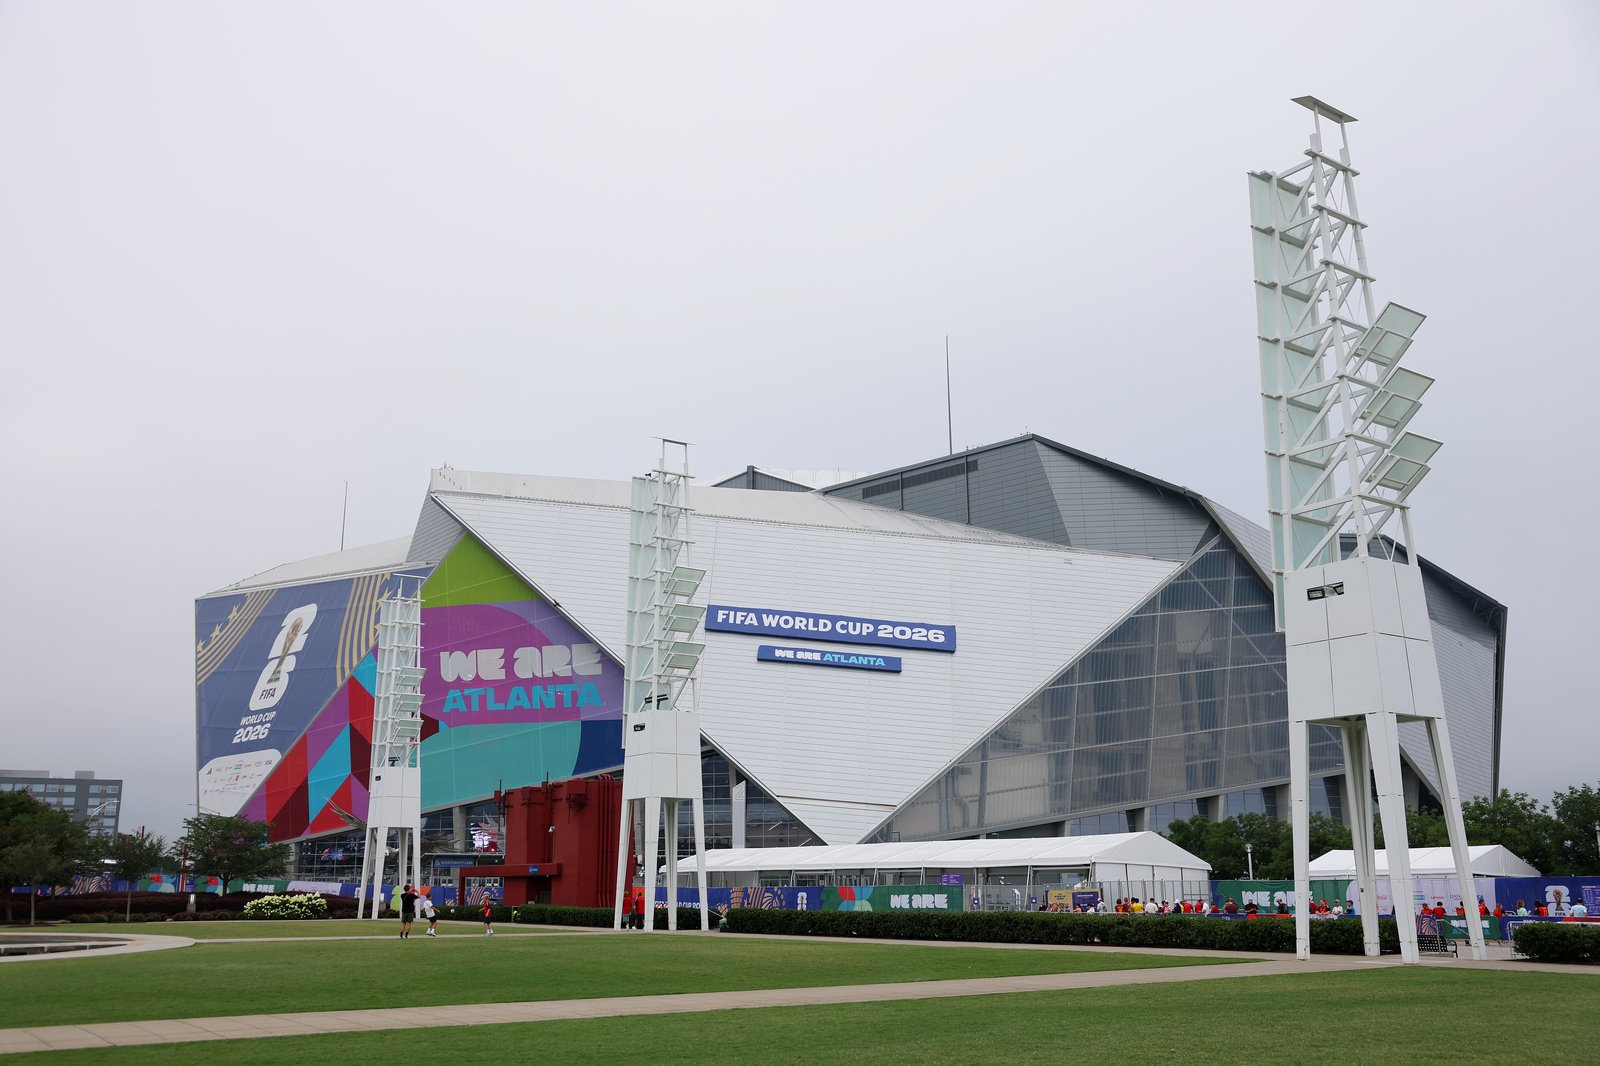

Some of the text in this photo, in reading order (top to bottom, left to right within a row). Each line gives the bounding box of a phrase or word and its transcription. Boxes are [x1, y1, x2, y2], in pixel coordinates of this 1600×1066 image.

[717, 610, 946, 643] FIFA WORLD CUP 2026
[439, 648, 506, 682] WE
[774, 649, 794, 659] WE
[823, 653, 886, 667] ATLANTA
[259, 687, 277, 701] FIFA
[442, 682, 603, 713] ATLANTA
[240, 710, 277, 726] WORLD CUP
[232, 723, 271, 744] 2026
[736, 784, 745, 800] 2
[242, 883, 256, 893] WE
[890, 894, 910, 908] WE
[1242, 891, 1313, 906] WE AR
